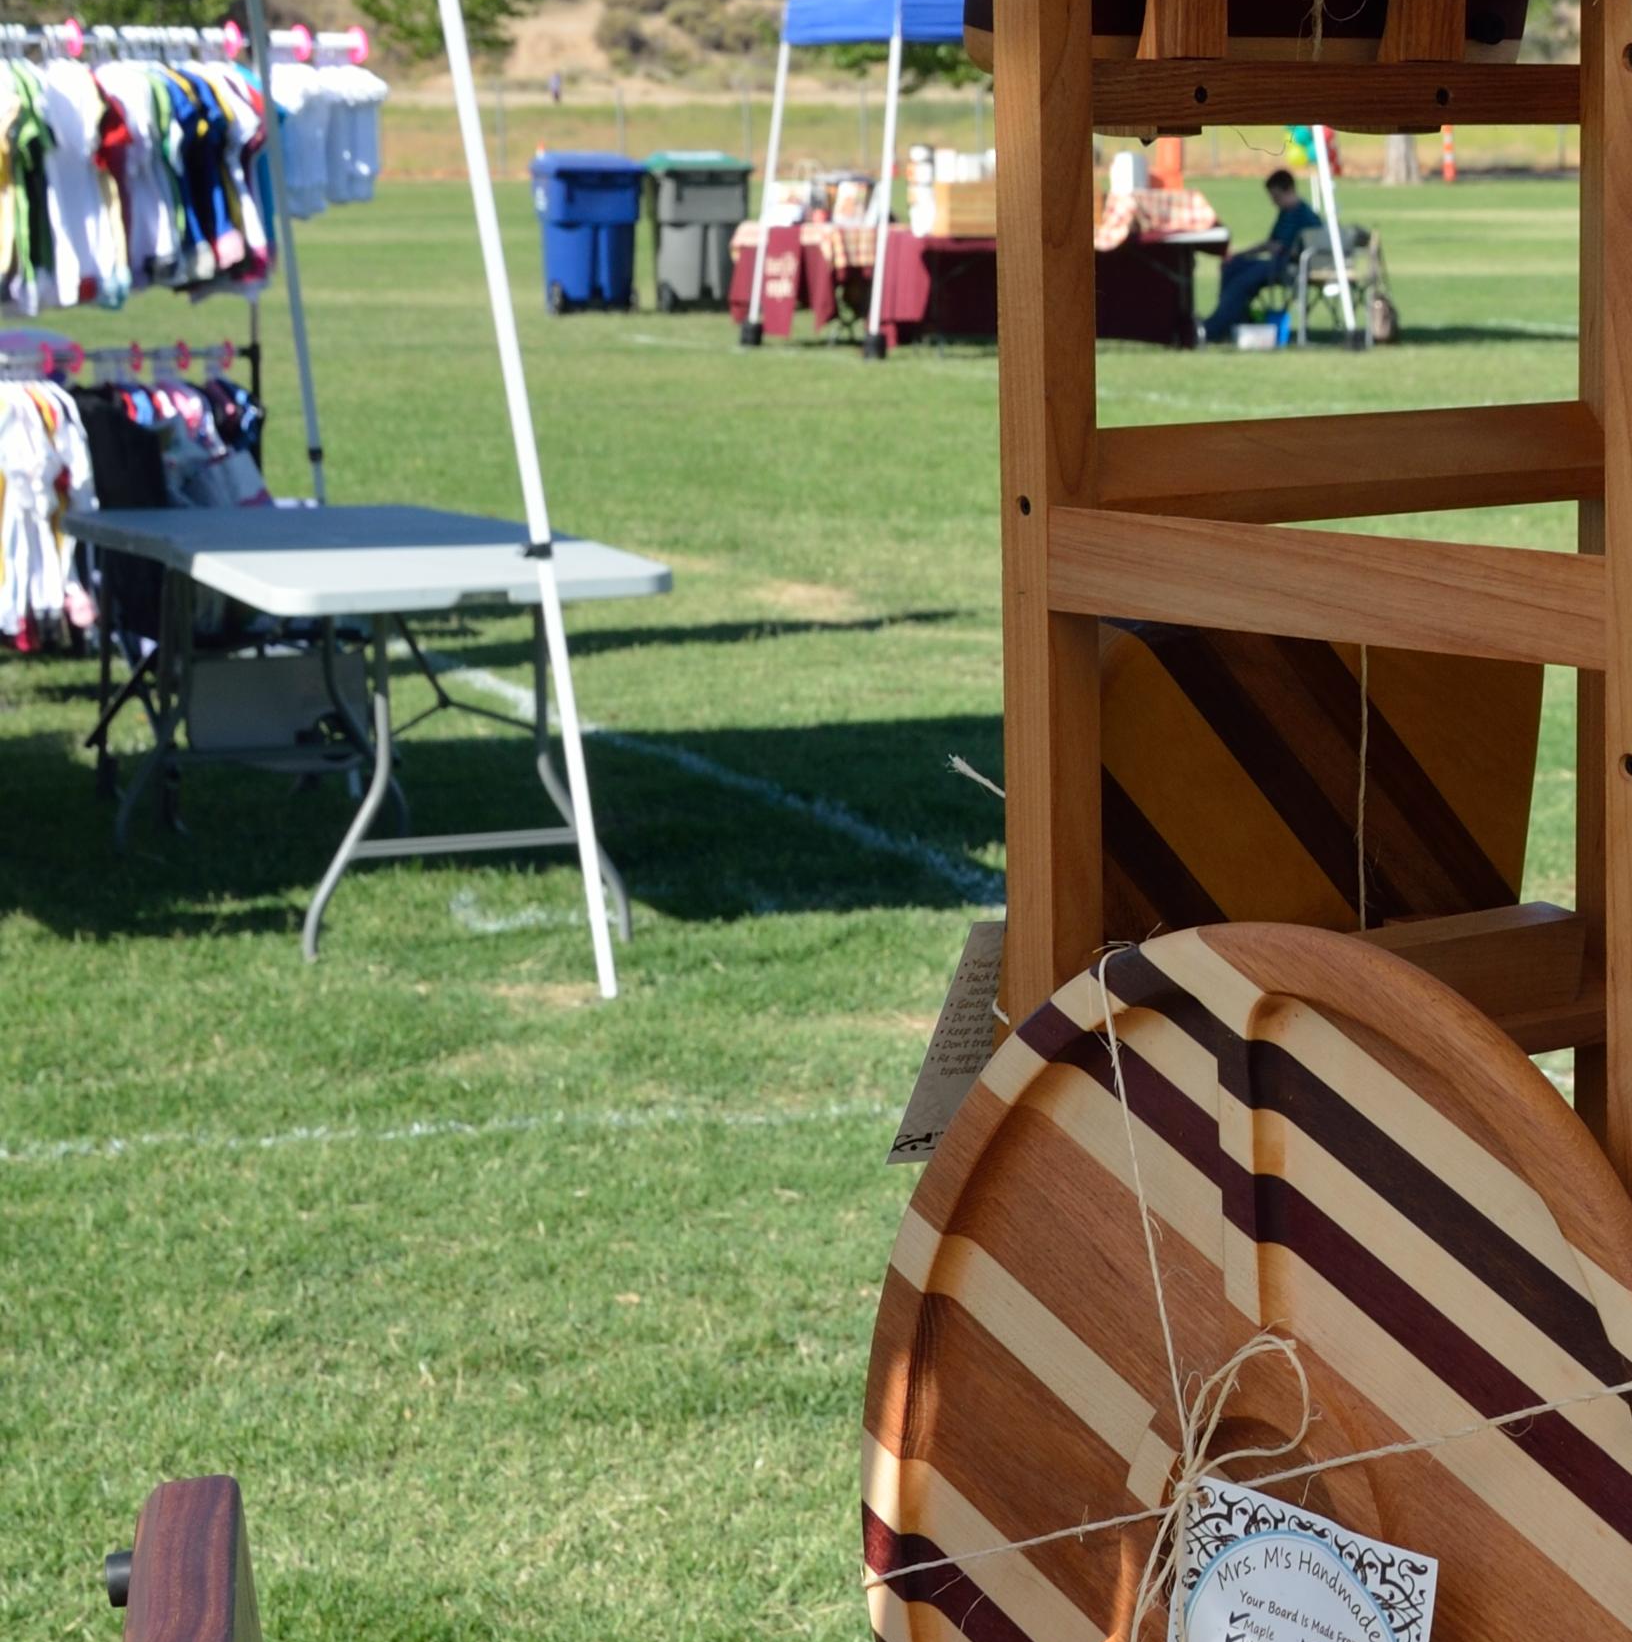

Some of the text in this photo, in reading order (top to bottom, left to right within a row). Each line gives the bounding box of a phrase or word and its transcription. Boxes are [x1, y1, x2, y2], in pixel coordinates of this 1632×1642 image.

[1216, 1560, 1256, 1590] Mrs.
[1264, 1547, 1292, 1570] M's
[1240, 1589, 1264, 1613] Your
[1267, 1601, 1298, 1622] Board
[1311, 1621, 1335, 1641] Made
[1243, 1619, 1275, 1641] Maple
